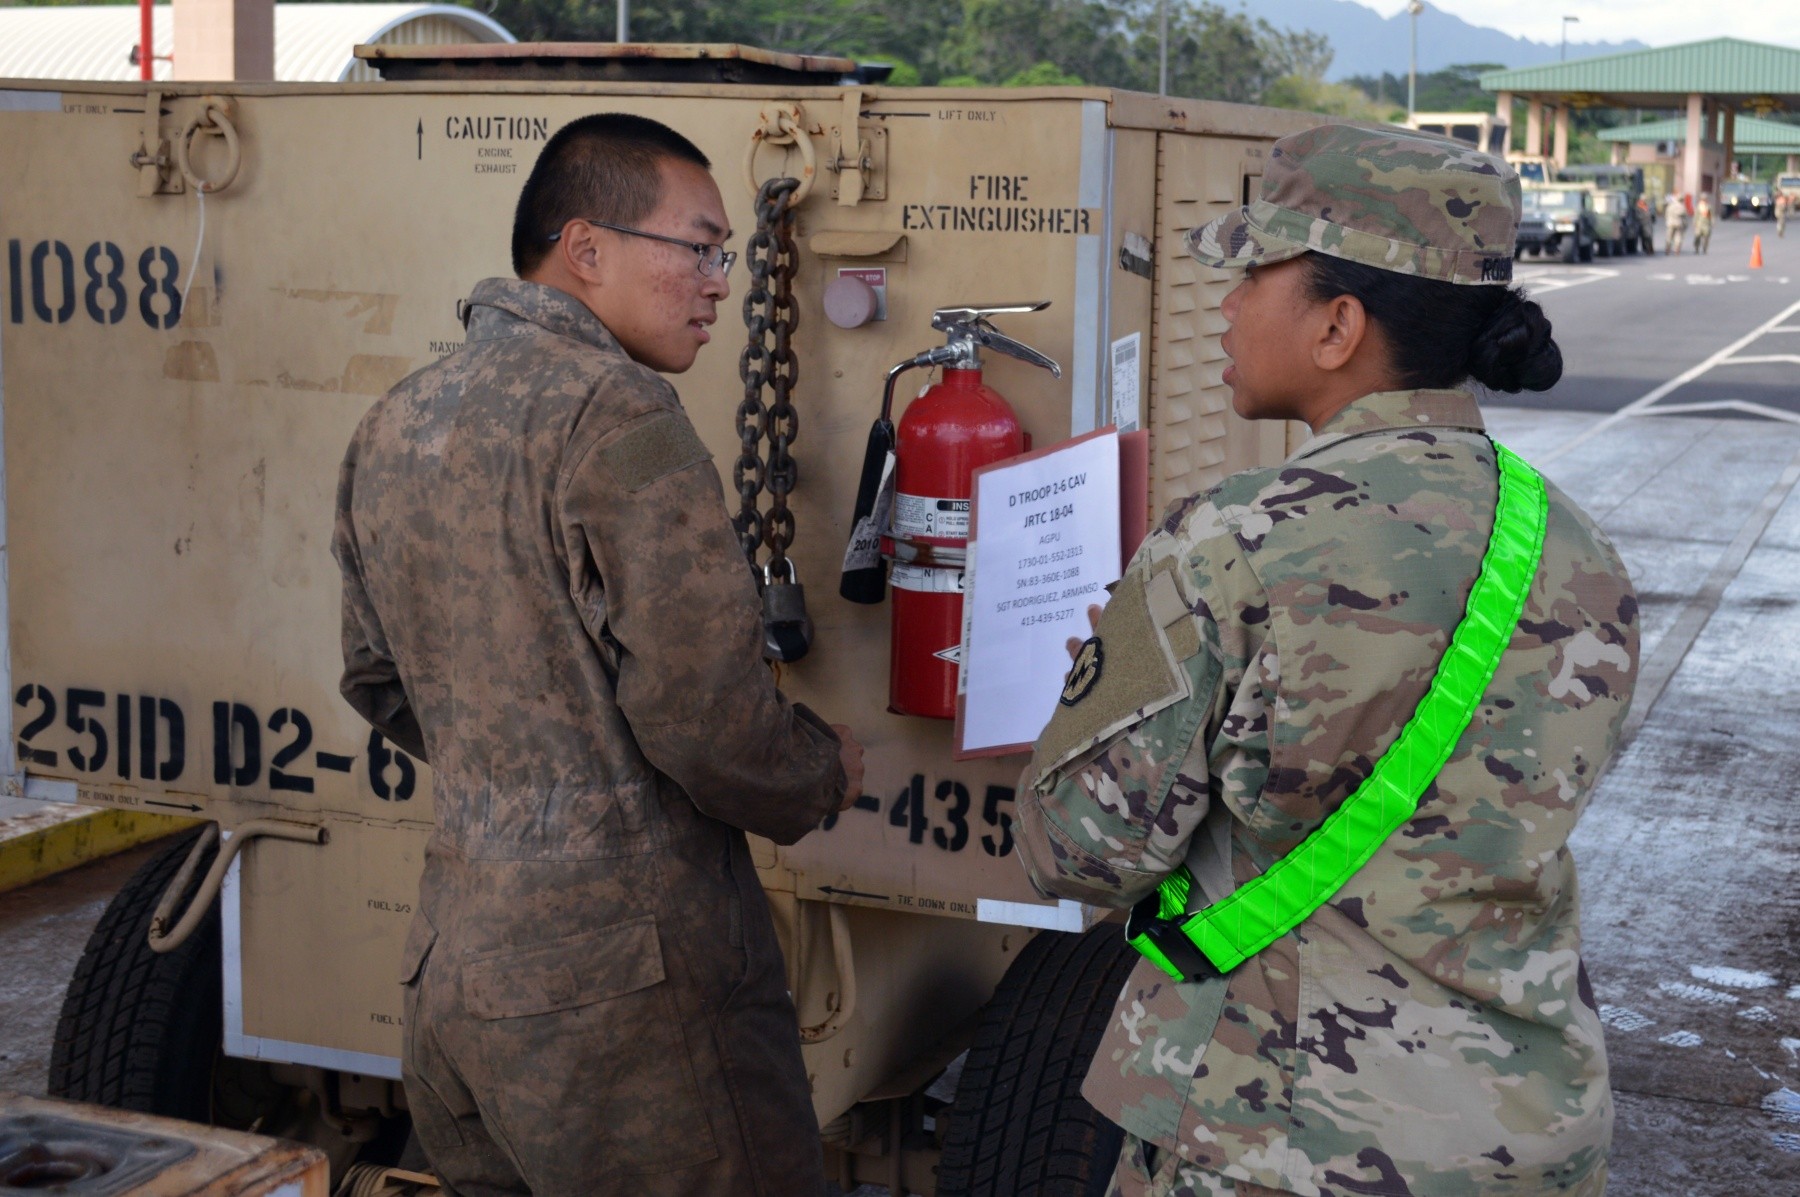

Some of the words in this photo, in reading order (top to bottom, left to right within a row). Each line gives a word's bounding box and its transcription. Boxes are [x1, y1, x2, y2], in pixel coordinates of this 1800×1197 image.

[63, 104, 82, 114] LIFT
[85, 105, 107, 115] ONLY
[938, 110, 962, 121] LIFT
[967, 110, 997, 122] ONLY
[446, 116, 547, 141] CAUTION
[478, 148, 513, 158] ENGINE
[474, 163, 517, 174] EXHAUST
[970, 175, 1029, 201] FIRE
[902, 205, 1090, 234] EXTINGUISHER
[8, 238, 183, 330] 1088
[1009, 495, 1016, 507] D
[1019, 485, 1051, 504] TROOP
[1053, 479, 1067, 495] 2-6
[1068, 472, 1087, 489] CAV
[1024, 511, 1047, 528] JRTC
[1050, 503, 1073, 522] 18-04
[853, 538, 880, 553] 2010
[1039, 532, 1061, 545] AGPU
[997, 601, 1011, 613] SGT
[1021, 608, 1074, 626] 413-439-5277
[15, 683, 186, 782] 25ID
[93, 791, 115, 802] DOWN
[119, 793, 140, 806] ONLY
[367, 899, 391, 912] FUEL
[395, 902, 411, 914] 2/3
[897, 895, 913, 906] TIE
[918, 898, 945, 910] DOWN
[950, 901, 977, 915] ONLY
[370, 1012, 395, 1026] FUEL
